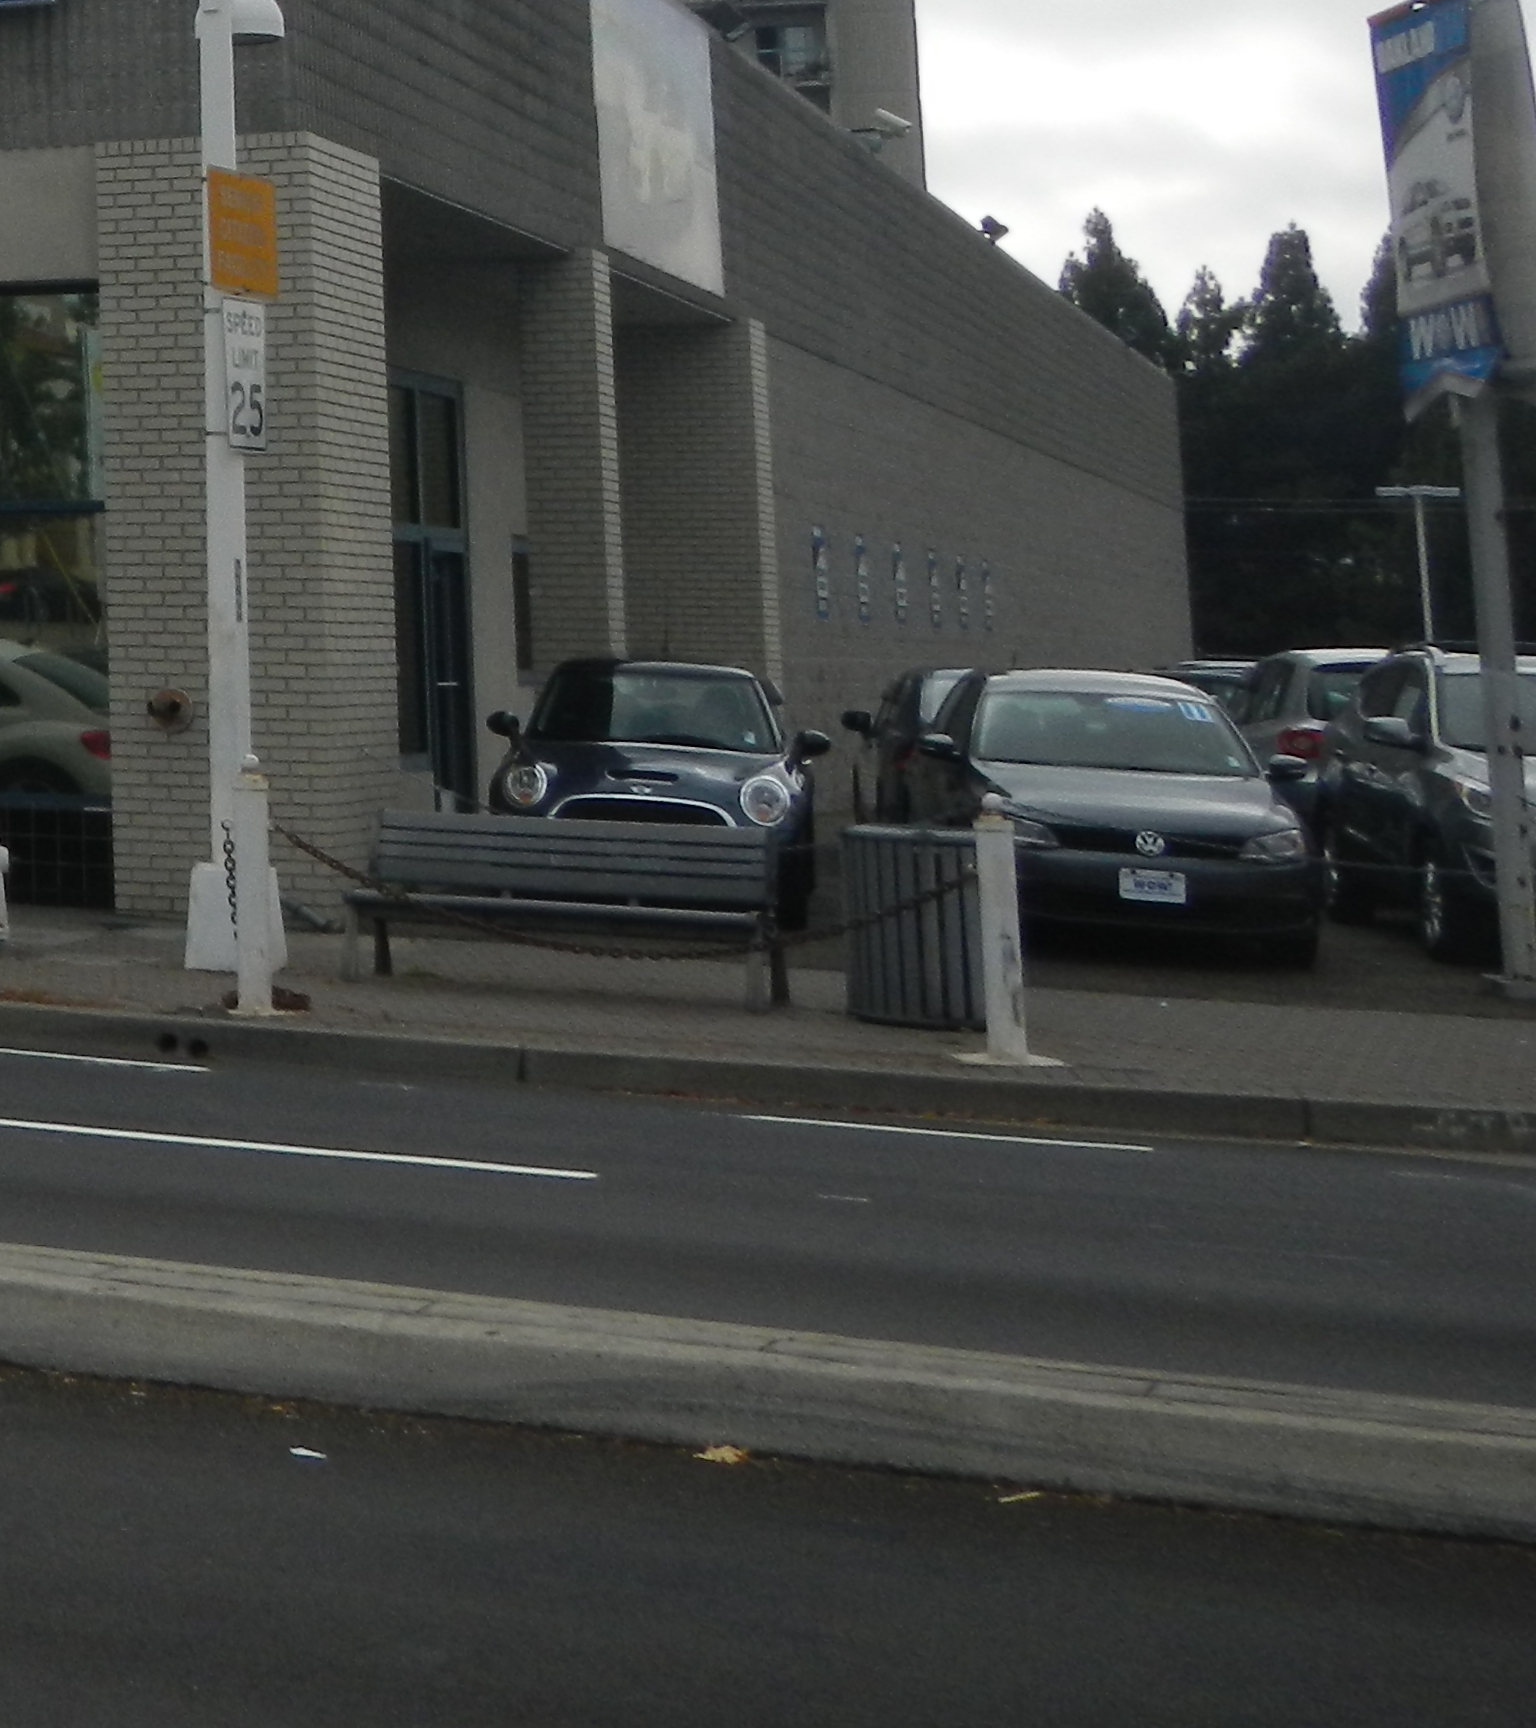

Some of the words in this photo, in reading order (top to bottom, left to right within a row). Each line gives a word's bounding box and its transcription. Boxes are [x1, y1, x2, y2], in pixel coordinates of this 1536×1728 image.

[227, 310, 263, 338] SPEED
[230, 346, 260, 370] LIMIT
[230, 380, 264, 437] 25
